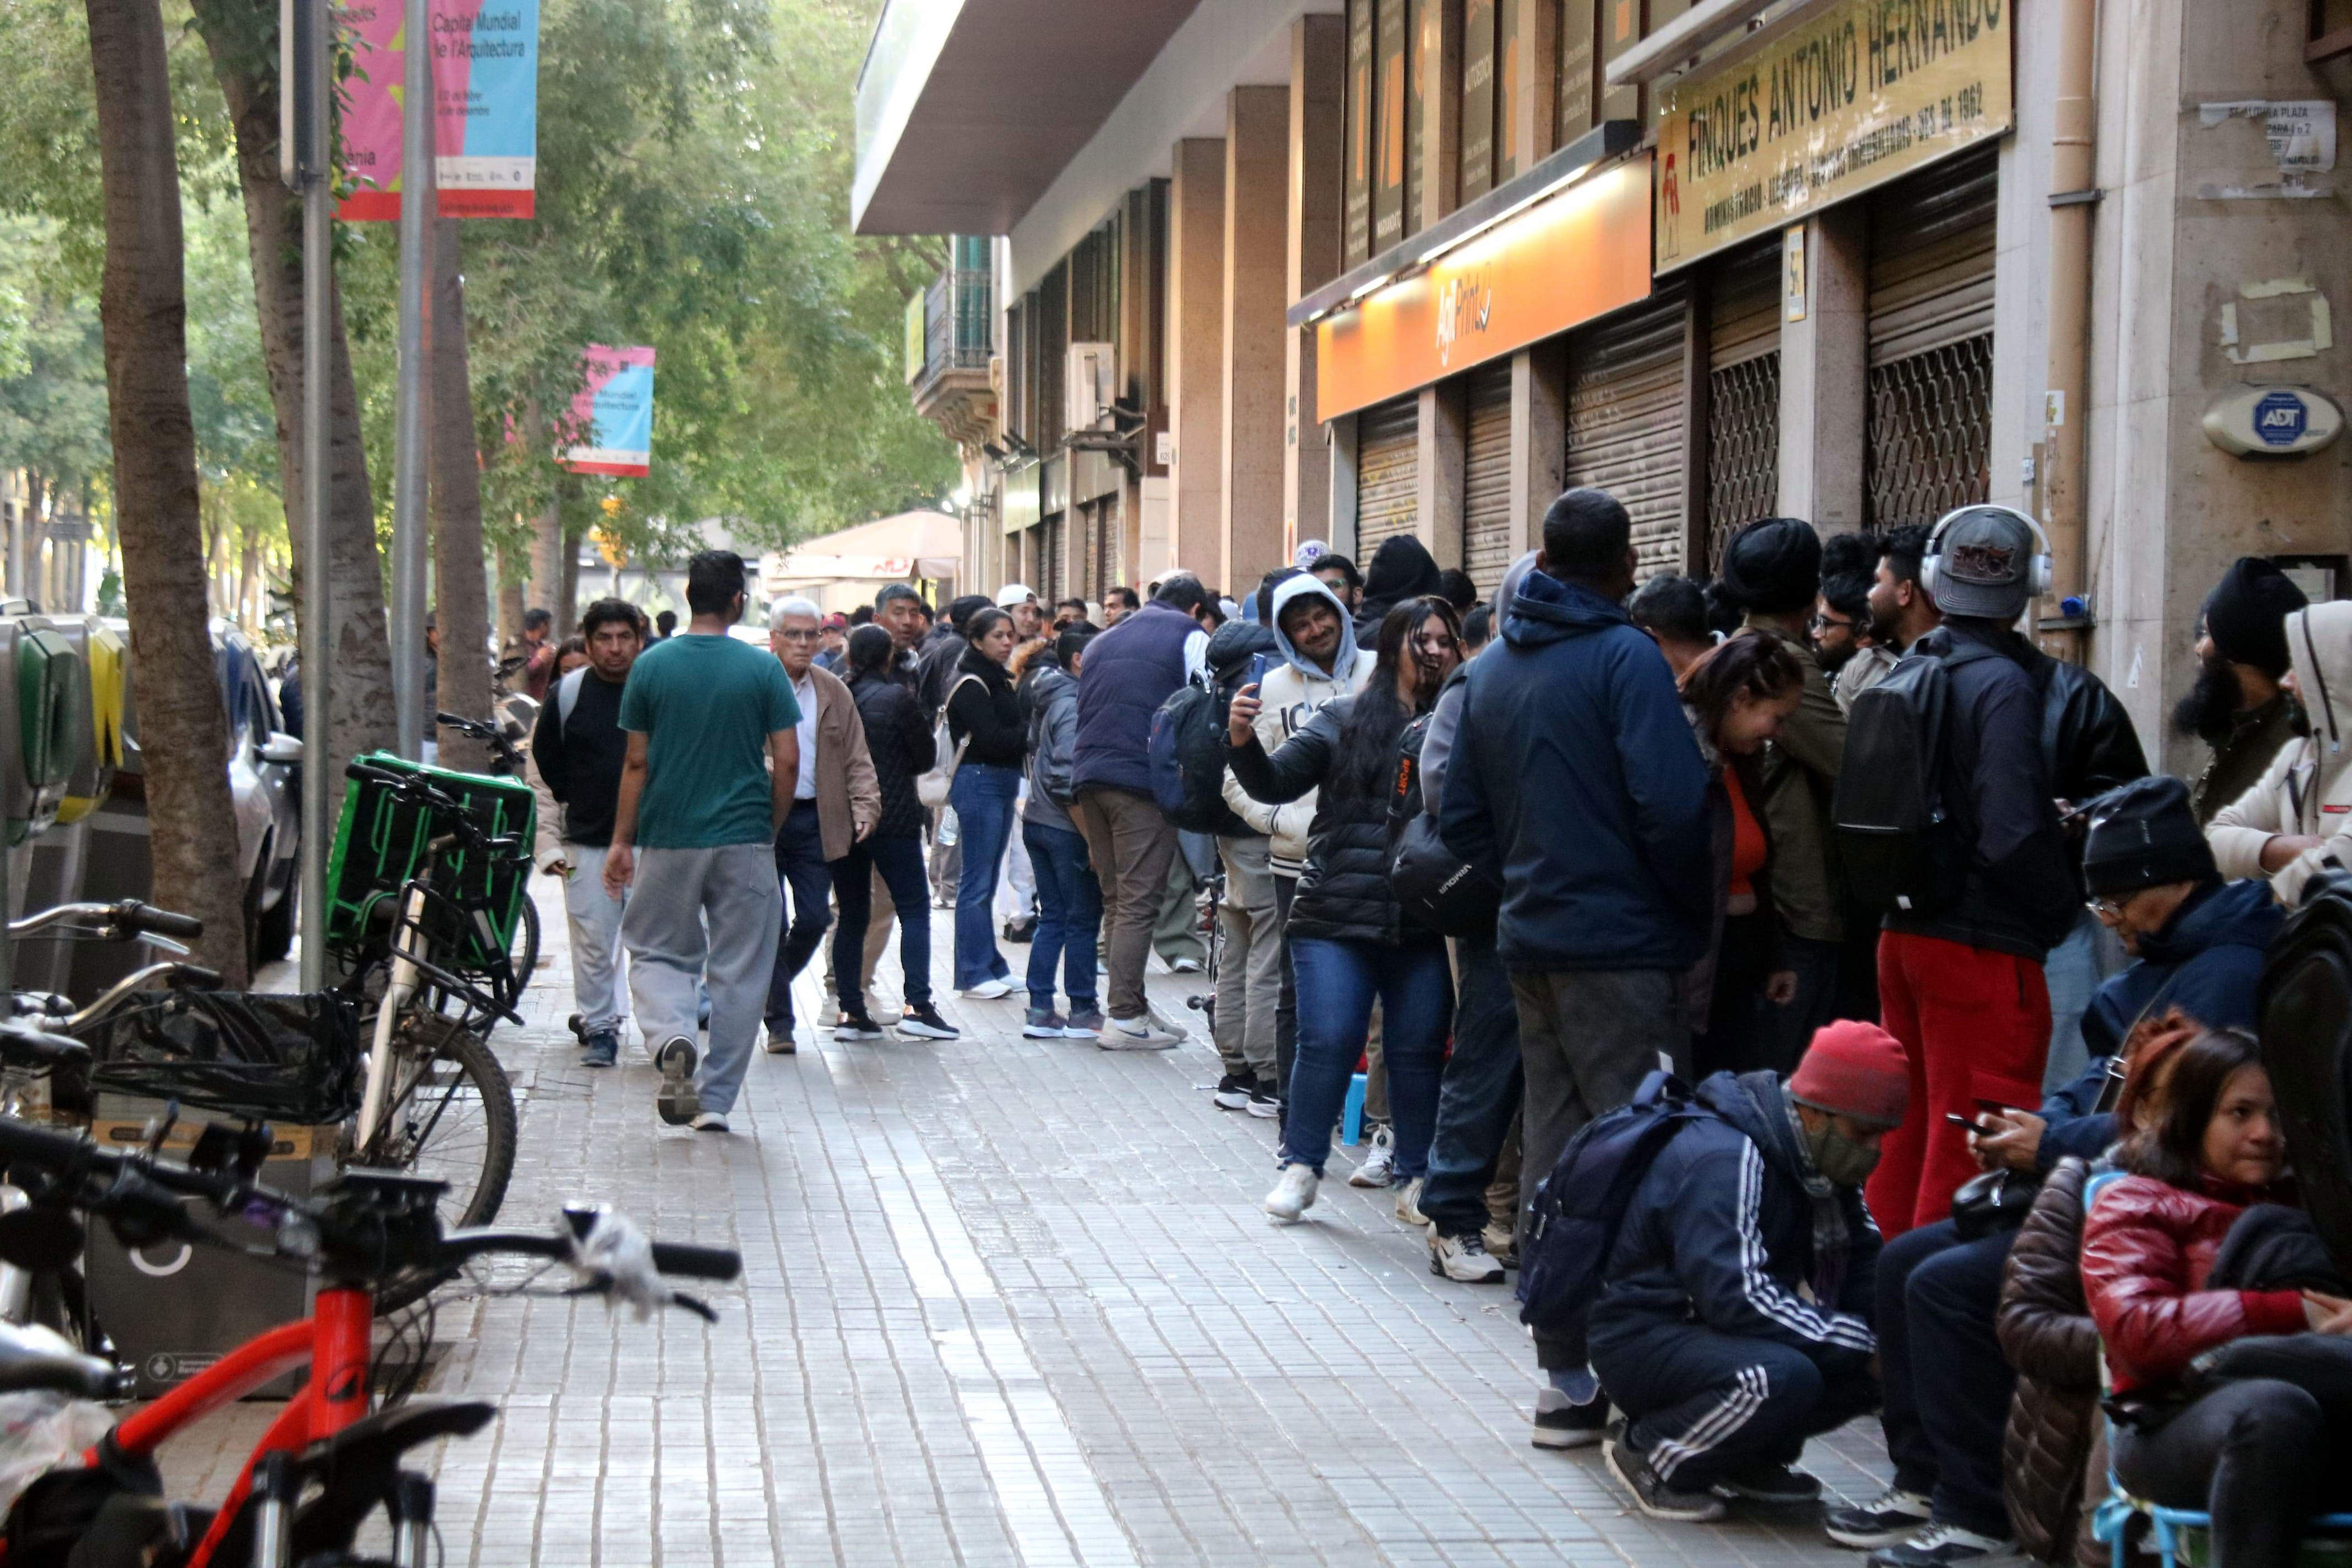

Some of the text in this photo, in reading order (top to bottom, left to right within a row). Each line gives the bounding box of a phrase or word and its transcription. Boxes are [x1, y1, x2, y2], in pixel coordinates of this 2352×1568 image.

[478, 10, 521, 32] Mundial
[1688, 0, 2002, 184] FINQUES ANTONIO HERNANDO
[1958, 81, 1982, 121] 1962
[2281, 107, 2308, 117] PLAZA
[1436, 272, 1481, 367] AgilPrint
[2263, 409, 2300, 427] ADT
[1397, 758, 1410, 795] SPORT
